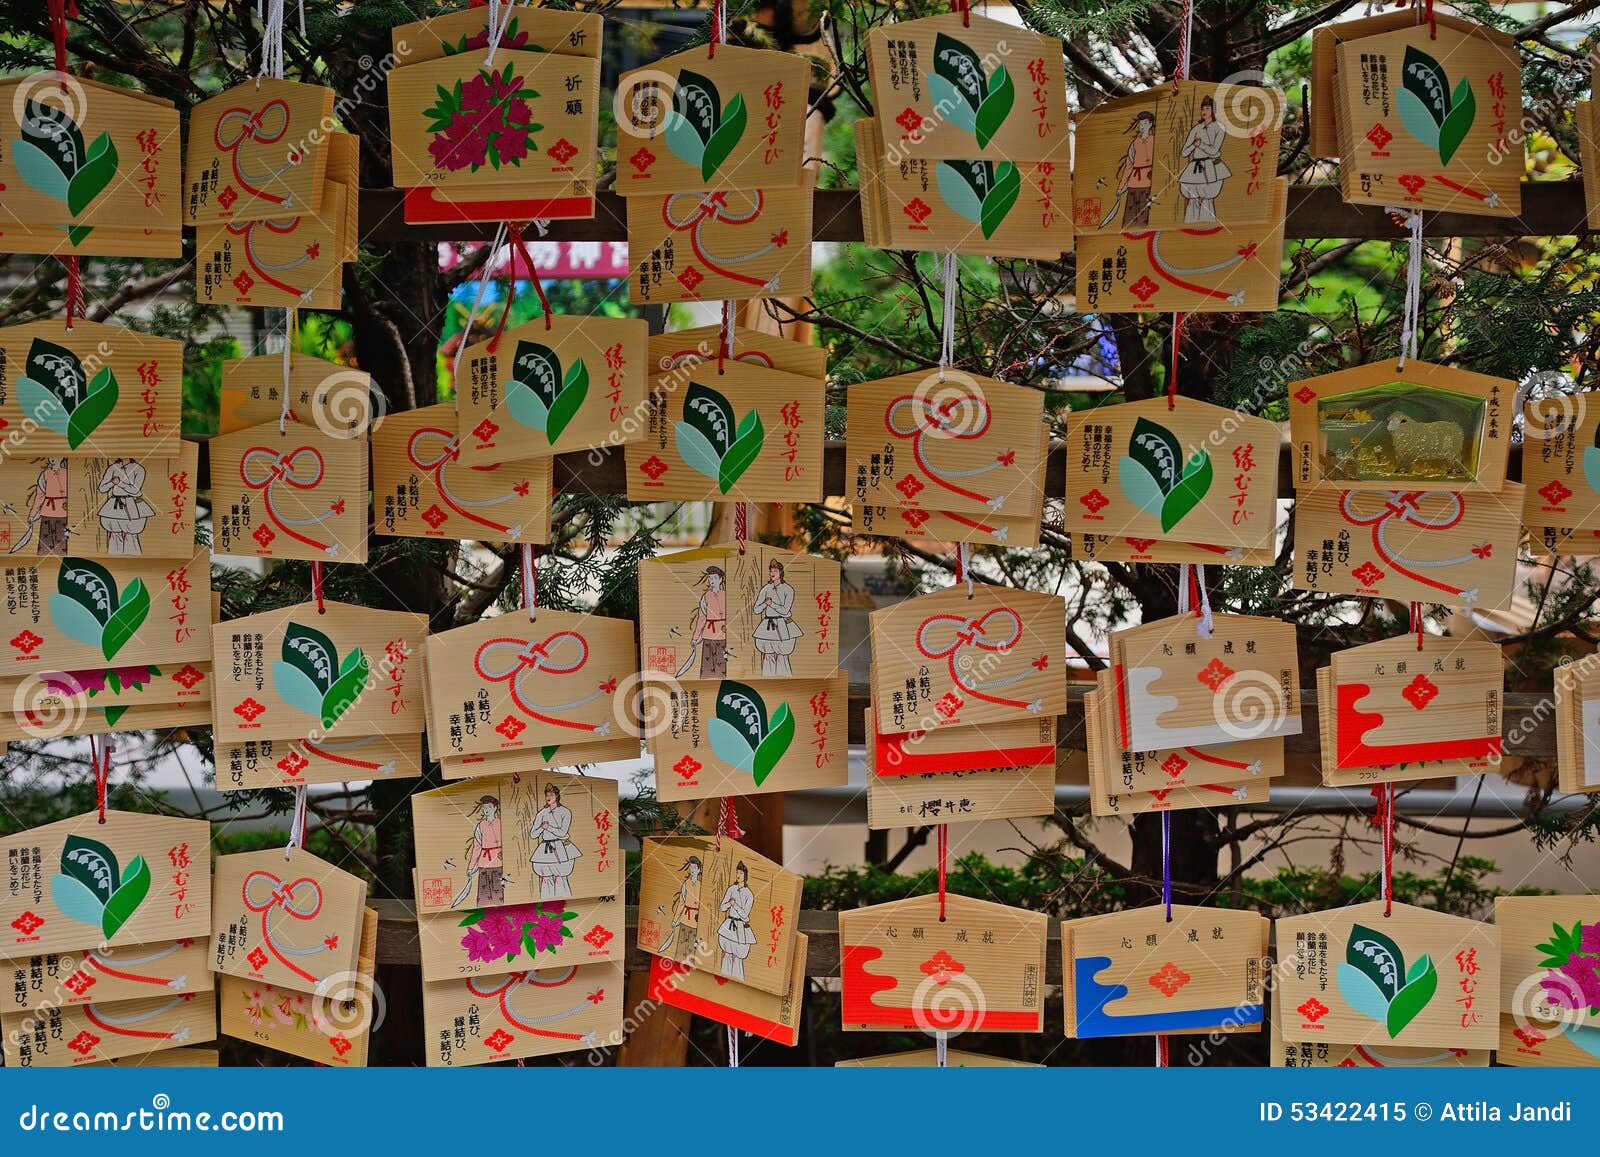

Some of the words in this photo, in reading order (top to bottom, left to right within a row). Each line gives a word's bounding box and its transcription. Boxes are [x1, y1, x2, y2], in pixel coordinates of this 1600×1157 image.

[569, 29, 587, 47] 祈
[887, 39, 901, 91] 願いをこめて
[897, 40, 909, 85] 鈴蘭の花に
[907, 41, 921, 103] 幸福をもたらす
[1360, 53, 1371, 106] 願いをこめて
[1369, 54, 1380, 99] 鈴蘭の花に
[565, 74, 584, 116] 祈願
[1027, 58, 1056, 139] 縁むすび
[1378, 54, 1390, 117] 幸福をもたらす
[762, 80, 786, 166] 縁むすび
[136, 128, 166, 208] 縁むすび
[209, 158, 220, 193] 心結び、
[190, 182, 199, 220] 幸結び。
[200, 169, 208, 207] 縁結び、
[214, 251, 222, 288] 縁結び、
[223, 240, 232, 277] 心結び、
[652, 250, 663, 288] 縁結び、
[664, 237, 675, 275] 心結び、
[1116, 245, 1128, 284] 心結び、
[204, 263, 213, 300] 幸結び。
[639, 262, 650, 301] 幸結び。
[1088, 271, 1099, 310] 幸結び。
[1102, 258, 1114, 296] 縁結び、
[471, 358, 480, 405] 願いをこめて
[480, 357, 488, 398] 鈴蘭の花に
[489, 356, 497, 411] 幸福をもたらす
[603, 343, 629, 422] 縁むすび
[137, 360, 163, 437] 縁むすび
[780, 401, 806, 481] 縁むすび
[1082, 425, 1092, 472] 願いをこめて
[1092, 425, 1102, 467] 鈴蘭の花に
[1102, 425, 1112, 484] 幸福をもたらす
[871, 454, 880, 491] 縁結び、
[884, 443, 894, 480] 心結び、
[169, 471, 190, 535] 縁むすび
[397, 485, 407, 521] 縁結び、
[409, 474, 419, 510] 心結び、
[857, 465, 867, 503] 幸結び。
[1229, 443, 1256, 526] 縁むすび
[231, 504, 241, 541] 縁結び、
[241, 494, 250, 529] 心結び、
[385, 496, 395, 533] 幸結び。
[221, 515, 231, 552] 幸結び。
[1338, 529, 1349, 567] 心結び、
[1306, 550, 1318, 588] 幸結び。
[1322, 540, 1333, 577] 縁結び、
[5, 568, 17, 615] 願いをこめて
[17, 567, 28, 608] 鈴蘭の花に
[28, 567, 40, 623] 幸福をもたらす
[166, 567, 196, 643] 縁むすび
[815, 591, 834, 654] 縁むすび
[232, 634, 241, 682] 願いをこめて
[243, 634, 252, 676] 鈴蘭の花に
[255, 634, 263, 691] 幸福をもたらす
[1162, 640, 1257, 656] 心願成就
[1375, 657, 1466, 675] 心願成就
[906, 678, 918, 715] 縁結び、
[919, 665, 932, 703] 心結び、
[464, 701, 477, 737] 縁結び、
[478, 688, 491, 725] 心結び、
[691, 691, 699, 748] 幸福をもたらす
[893, 691, 905, 730] 幸結び。
[450, 714, 463, 752] 幸結び。
[810, 691, 833, 768] 縁むすび
[230, 749, 244, 786] 幸結び。
[1121, 752, 1133, 789] 幸結び。
[594, 809, 613, 872] 縁むすび
[9, 848, 18, 896] 願いをこめて
[20, 848, 30, 889] 鈴蘭の花に
[31, 847, 42, 904] 幸福をもたらす
[168, 842, 195, 919] 縁むすび
[767, 905, 784, 968] 縁むすび
[886, 926, 994, 944] 心願成就
[1121, 927, 1224, 949] 心願成就
[1307, 932, 1316, 975] 鈴蘭の花に
[1318, 932, 1327, 991] 幸福をもたらす
[15, 969, 27, 1007] 幸結び。
[1456, 948, 1485, 1028] 縁むすび
[454, 1017, 466, 1051] 縁結び、
[468, 1004, 480, 1038] 心結び、
[440, 1030, 452, 1065] 幸結び。
